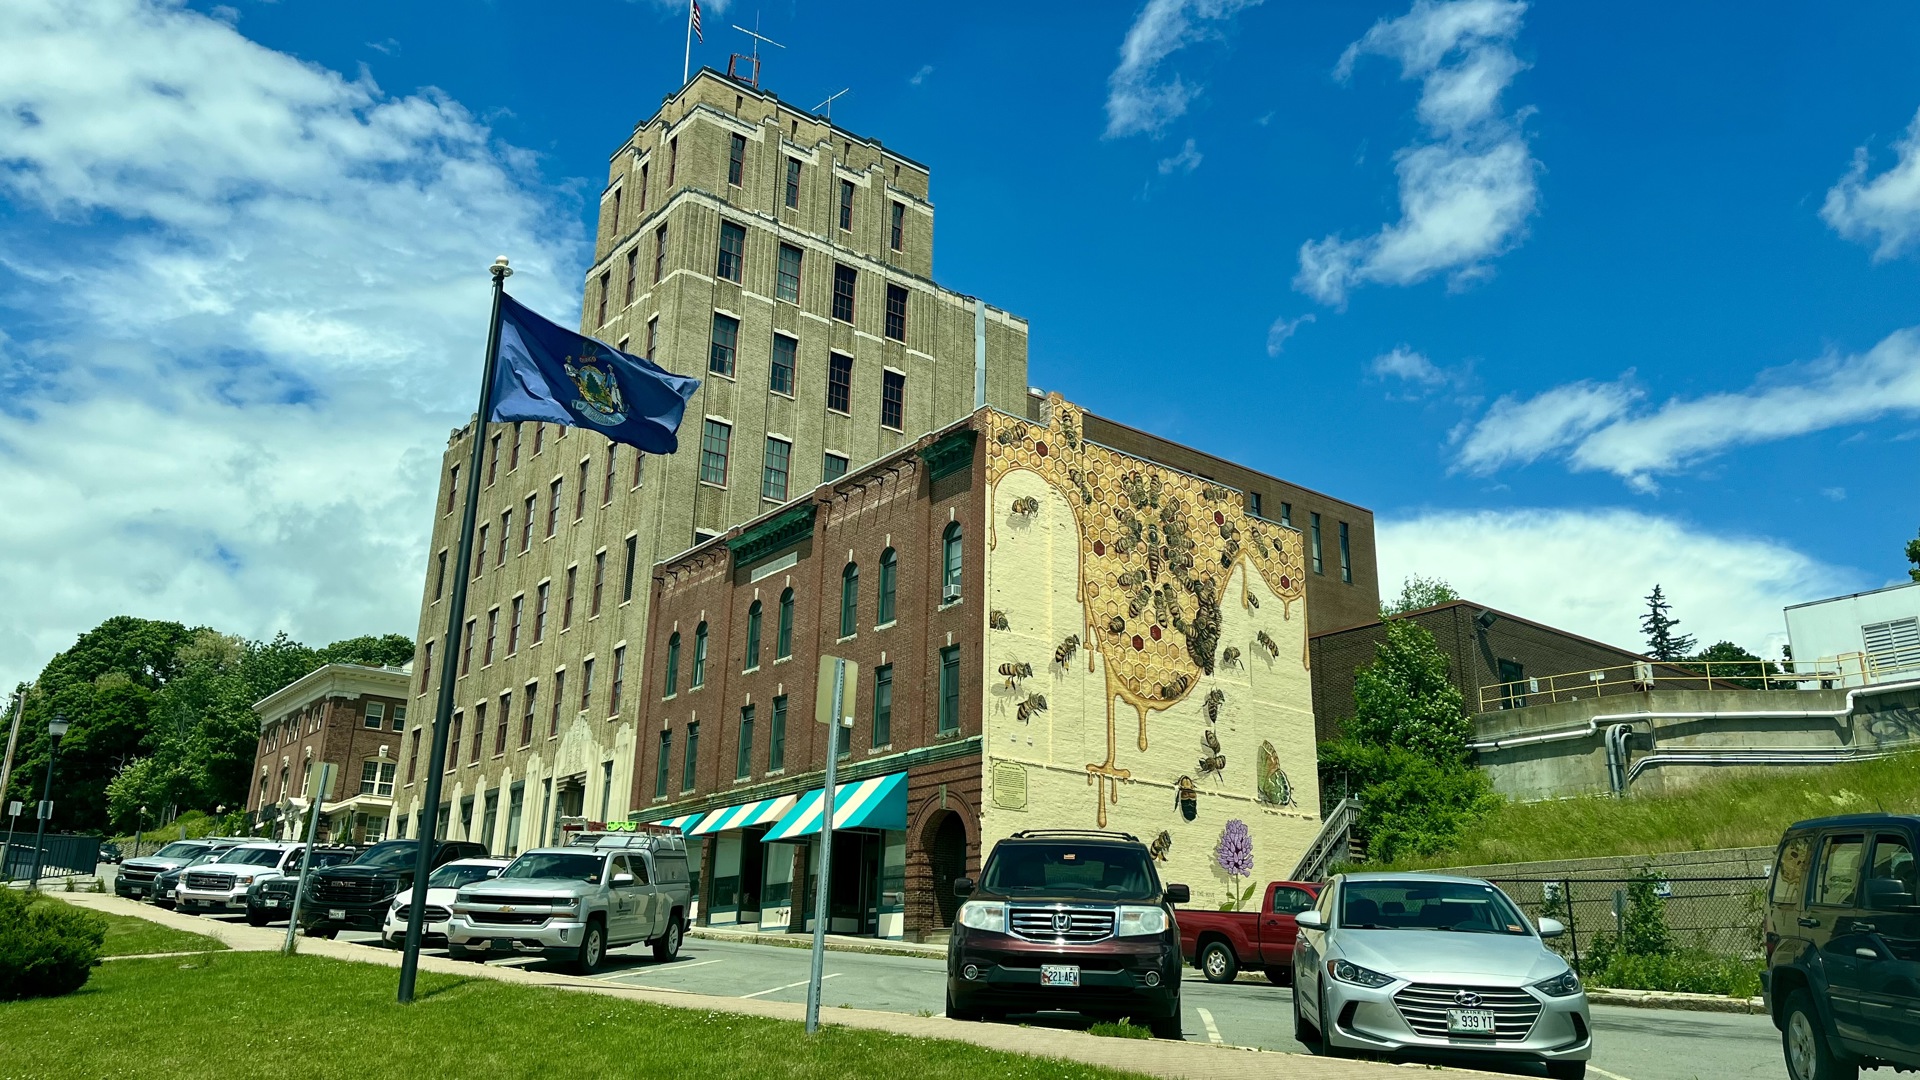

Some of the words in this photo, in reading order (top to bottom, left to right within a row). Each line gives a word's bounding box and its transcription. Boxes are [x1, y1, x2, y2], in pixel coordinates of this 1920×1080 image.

[331, 880, 356, 888] GMC
[1048, 971, 1078, 982] 221-AEW
[1461, 1015, 1479, 1028] 939
[1481, 1016, 1493, 1029] YT
